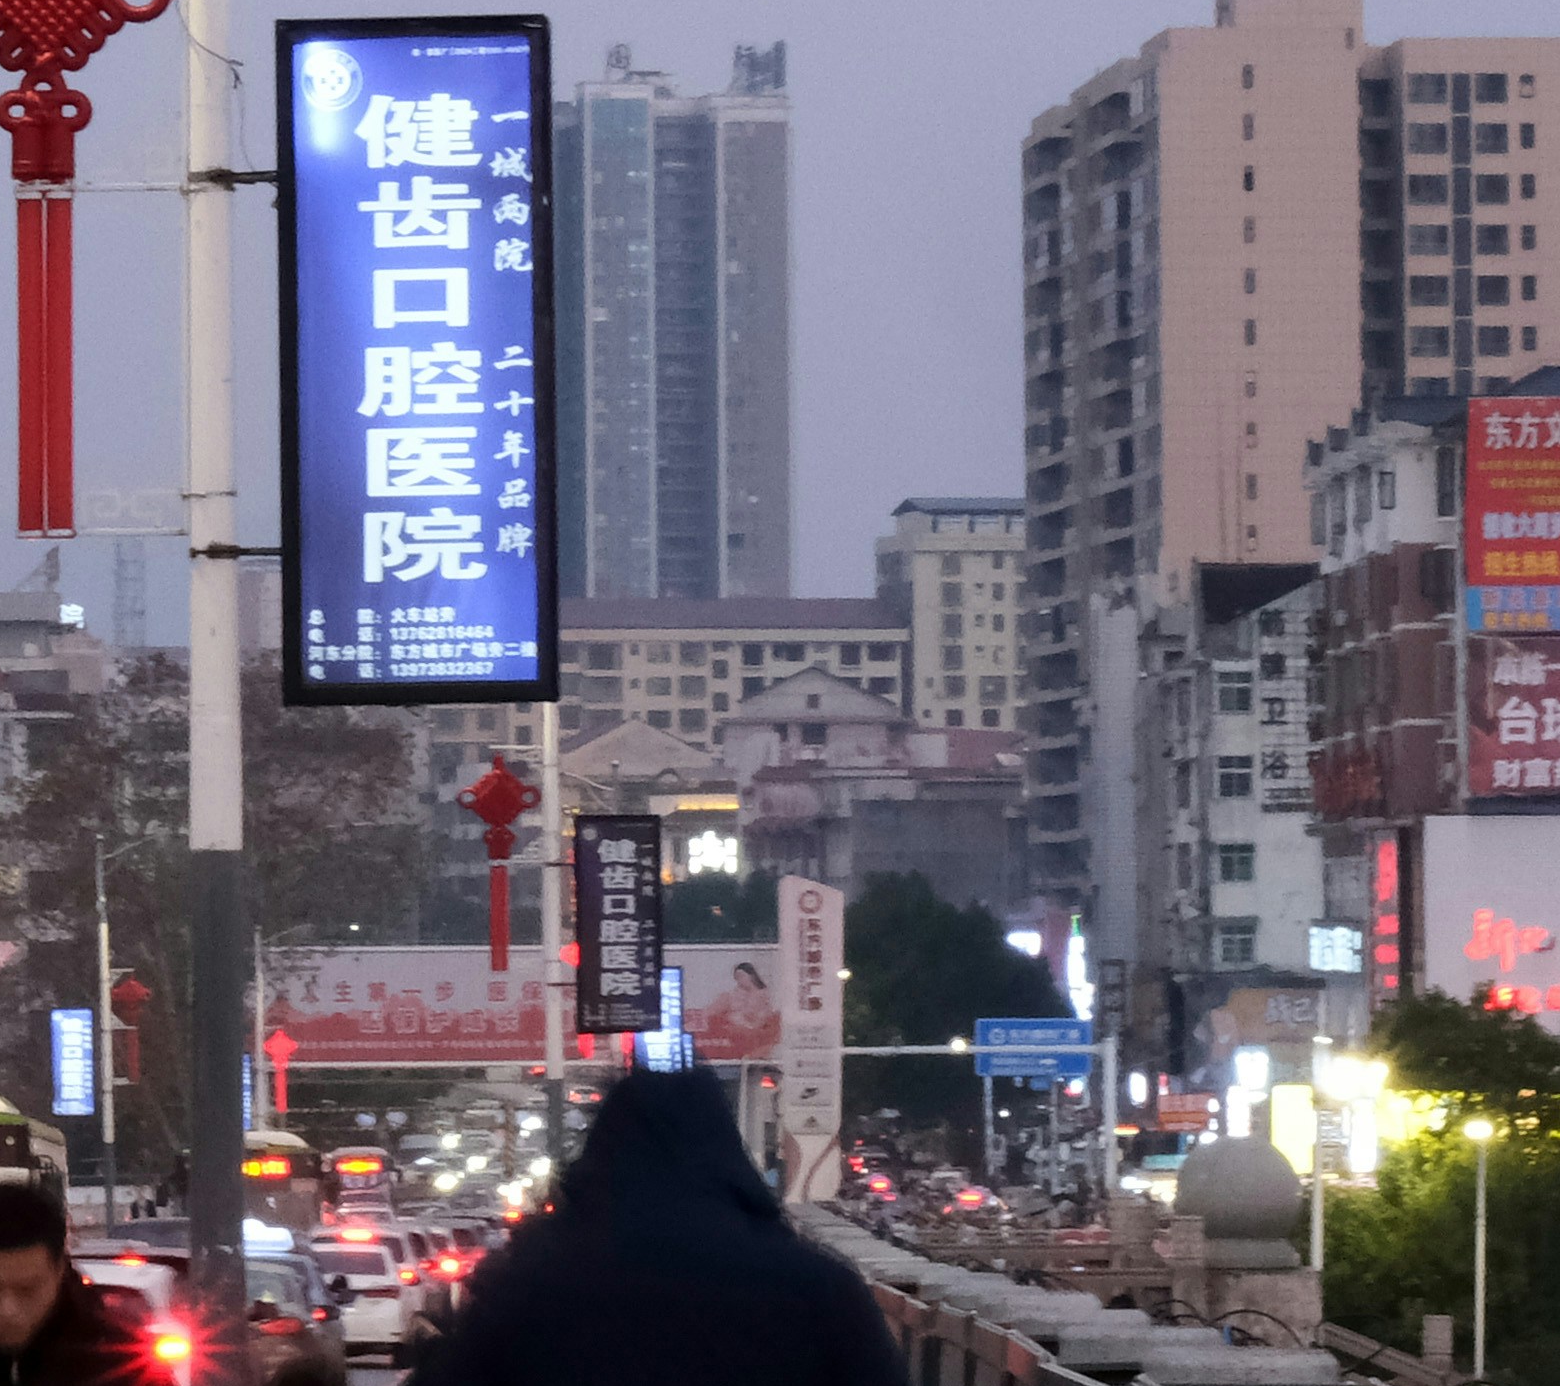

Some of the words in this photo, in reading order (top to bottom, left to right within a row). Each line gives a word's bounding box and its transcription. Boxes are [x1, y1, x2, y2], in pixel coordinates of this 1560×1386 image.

[489, 108, 533, 274] 一城两院
[355, 91, 488, 584] 健齿口腔医院
[492, 345, 536, 557] 二十年品牌
[597, 838, 642, 998] 健齿口腔医院
